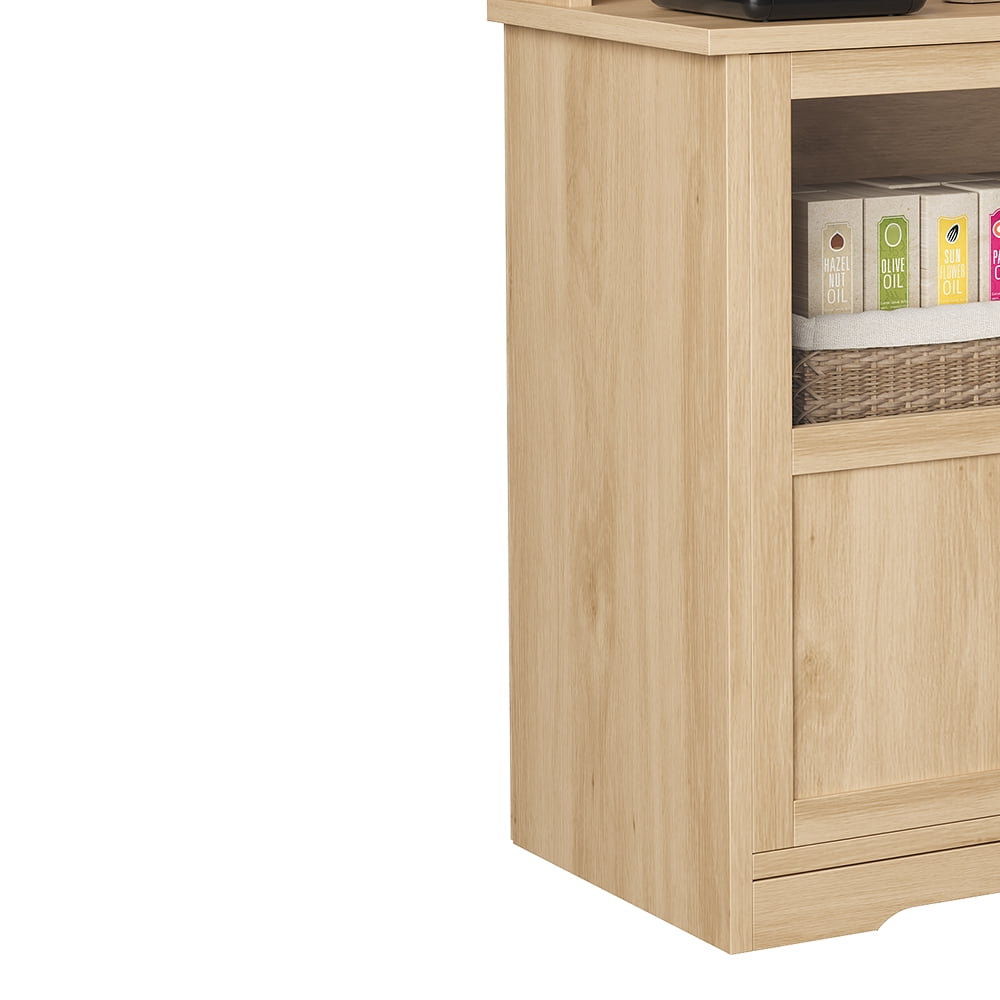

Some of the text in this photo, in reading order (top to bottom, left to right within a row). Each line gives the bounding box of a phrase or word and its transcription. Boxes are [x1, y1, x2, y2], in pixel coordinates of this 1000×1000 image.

[824, 256, 850, 273] HAZEL
[944, 249, 960, 264] SUN
[881, 257, 905, 274] OLIVE
[829, 272, 845, 288] NUT
[883, 274, 903, 290] OIL
[943, 280, 962, 296] OIL
[827, 289, 848, 304] OIL
